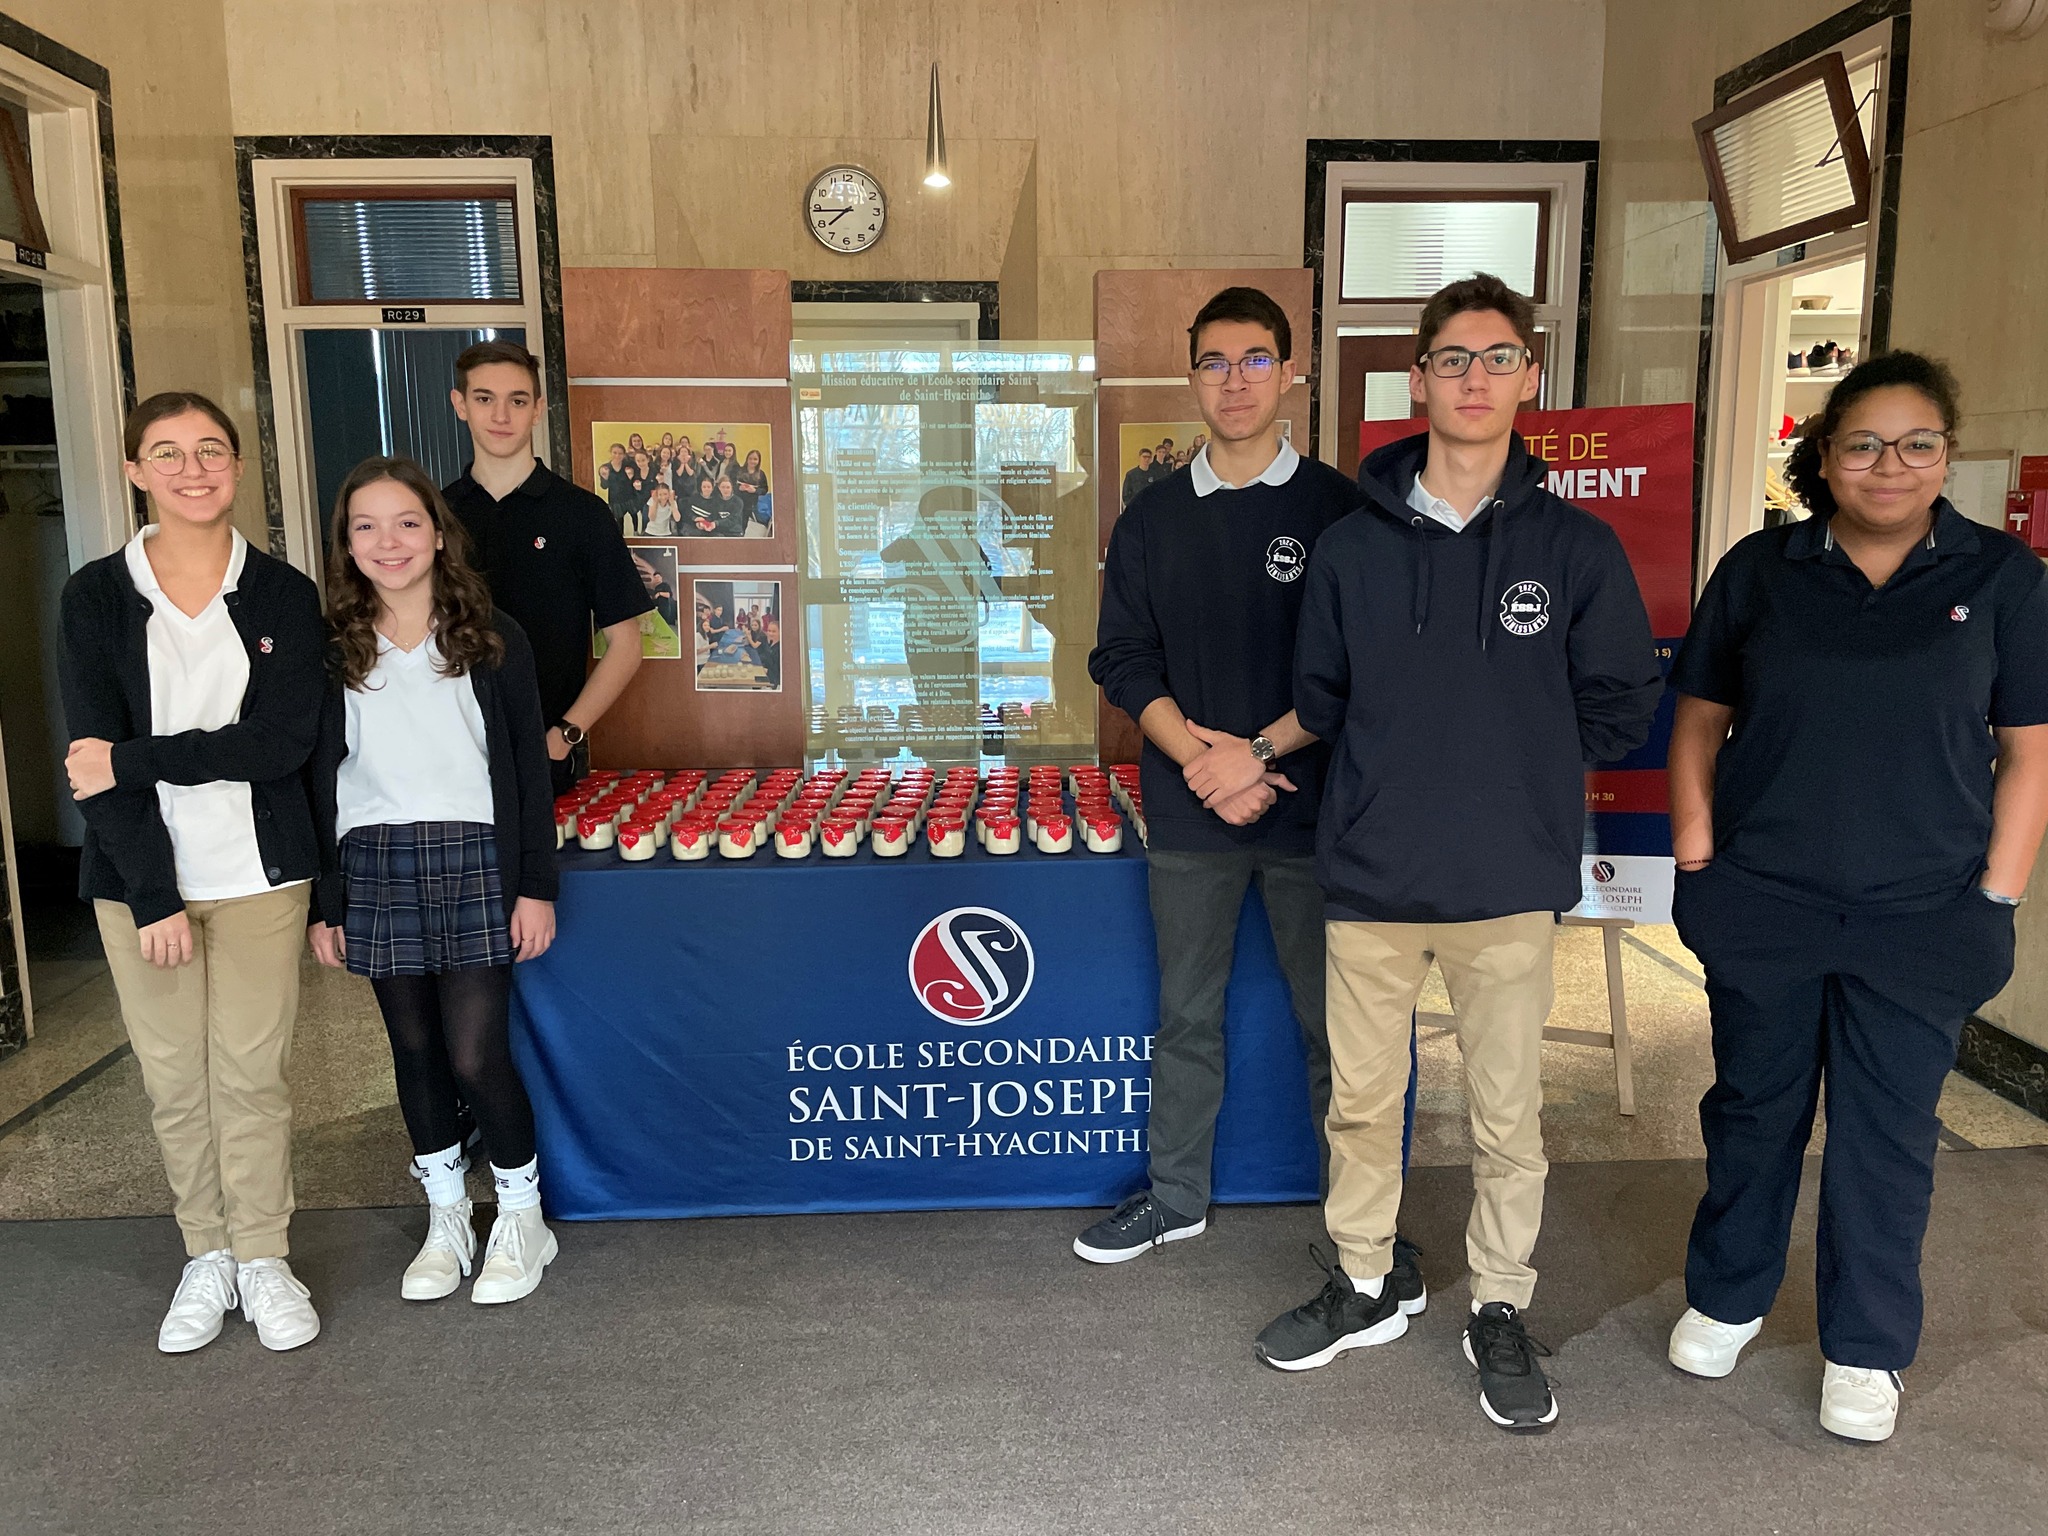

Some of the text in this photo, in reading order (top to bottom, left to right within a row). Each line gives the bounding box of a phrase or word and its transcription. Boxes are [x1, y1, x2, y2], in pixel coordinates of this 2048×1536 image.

[830, 178, 837, 186] 11
[842, 174, 853, 182] 12
[818, 189, 827, 197] 10
[868, 192, 876, 200] 2
[872, 208, 880, 216] 3
[818, 220, 826, 228] 8
[828, 232, 835, 240] 7
[387, 310, 420, 320] RC29
[822, 374, 857, 386] Mission
[860, 374, 904, 386] éducative
[908, 374, 918, 386] de
[956, 374, 1005, 386] secondaire
[900, 390, 911, 400] de
[1570, 432, 1608, 460] DE
[1537, 466, 1647, 499] MENT
[1519, 584, 1537, 592] 2024
[1504, 614, 1547, 633] FINISSANTS
[1602, 793, 1614, 801] 30
[1592, 886, 1642, 894] SECONDAIRE
[787, 1040, 904, 1072] ÉCOLE
[789, 1078, 1152, 1128] SAINT-JOSEPH
[790, 1136, 832, 1162] DE
